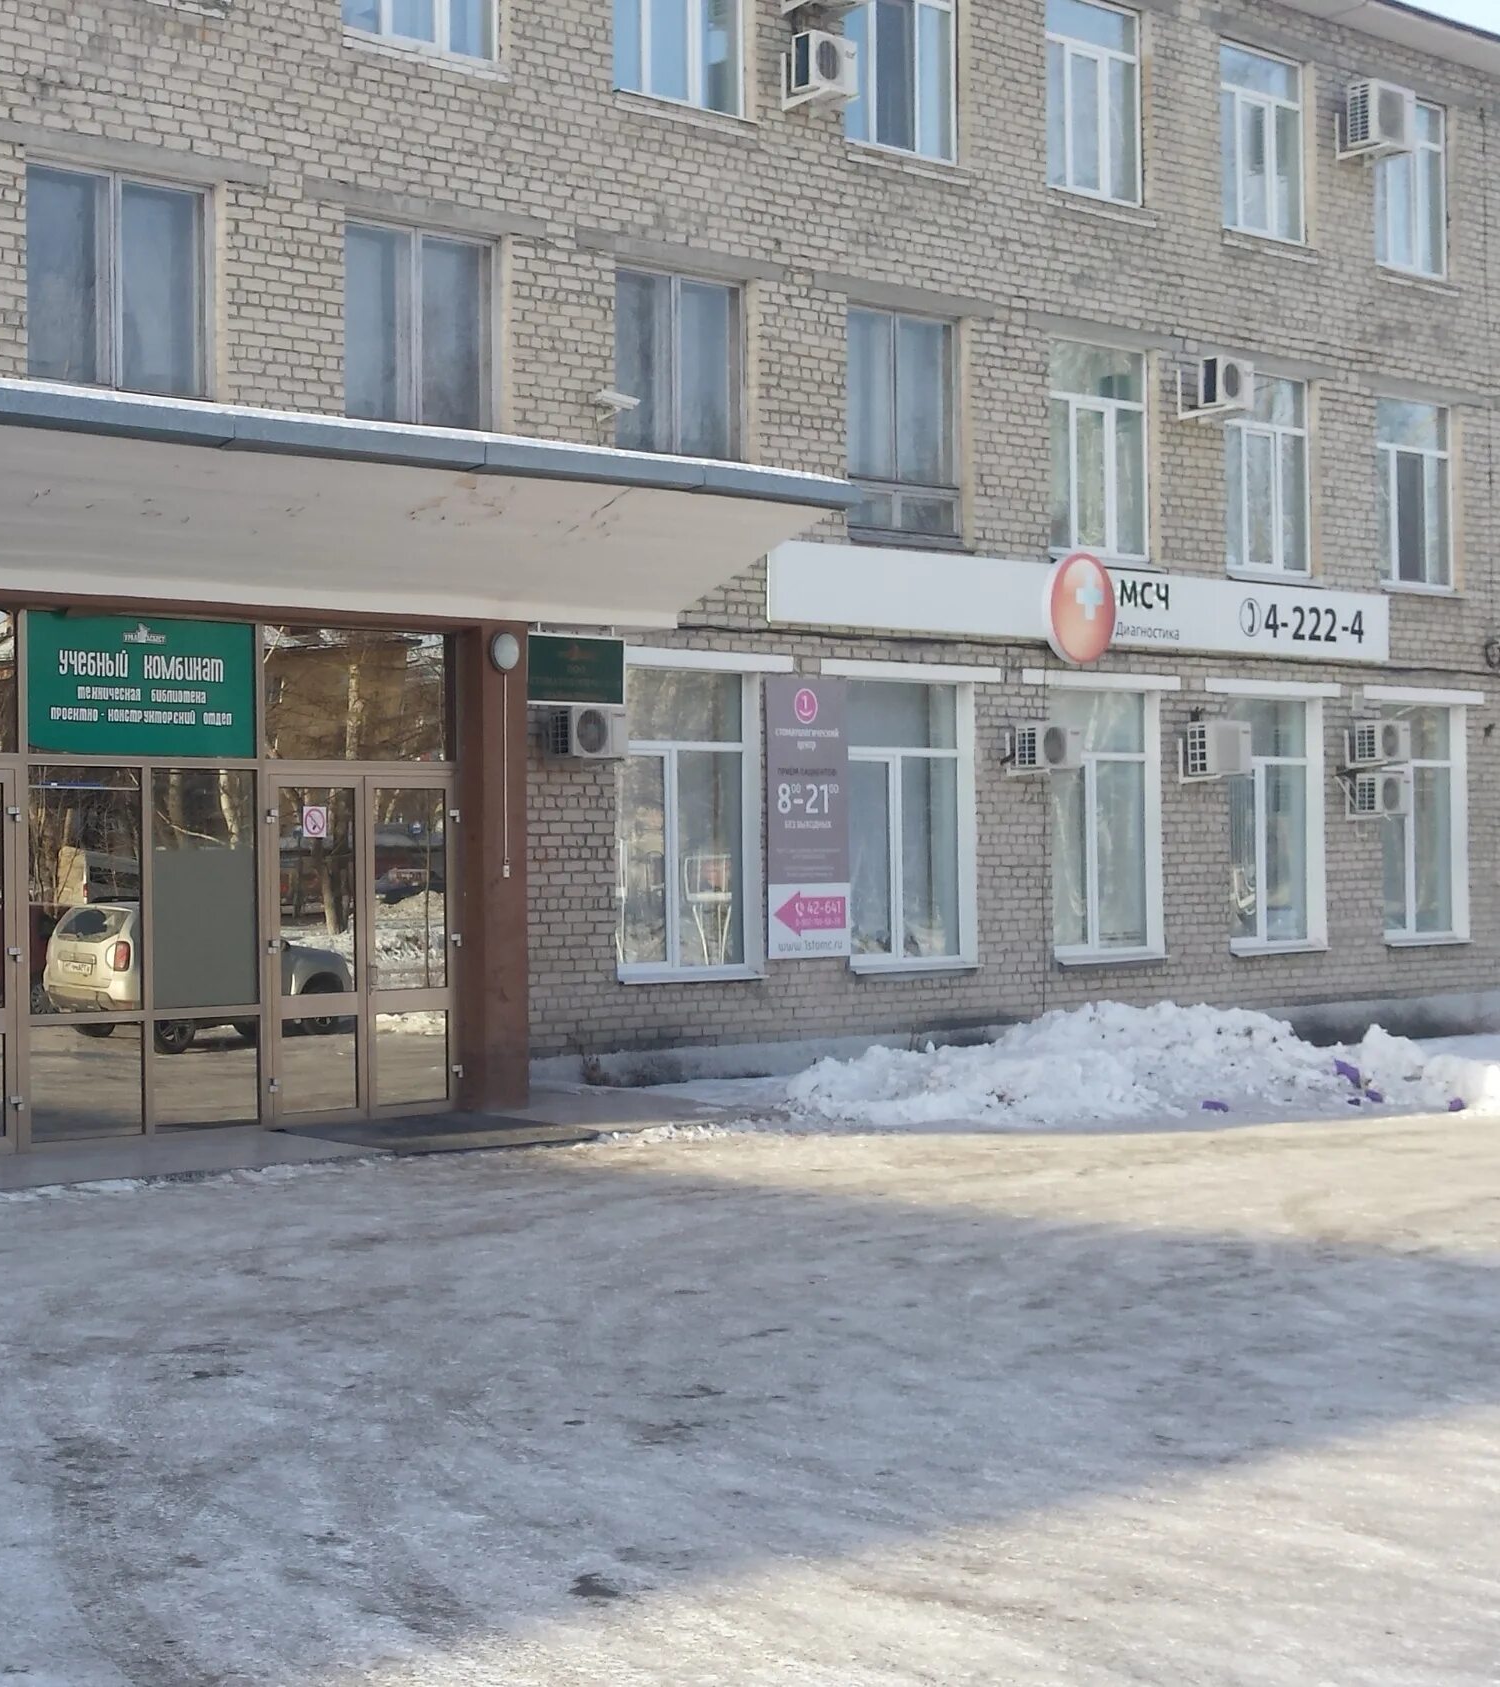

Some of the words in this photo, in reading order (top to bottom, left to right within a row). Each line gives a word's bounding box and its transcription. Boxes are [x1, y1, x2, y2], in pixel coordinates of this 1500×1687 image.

[1119, 579, 1170, 611] МСЧ
[1115, 621, 1180, 641] Диагностика
[1264, 603, 1365, 643] 4-222-4
